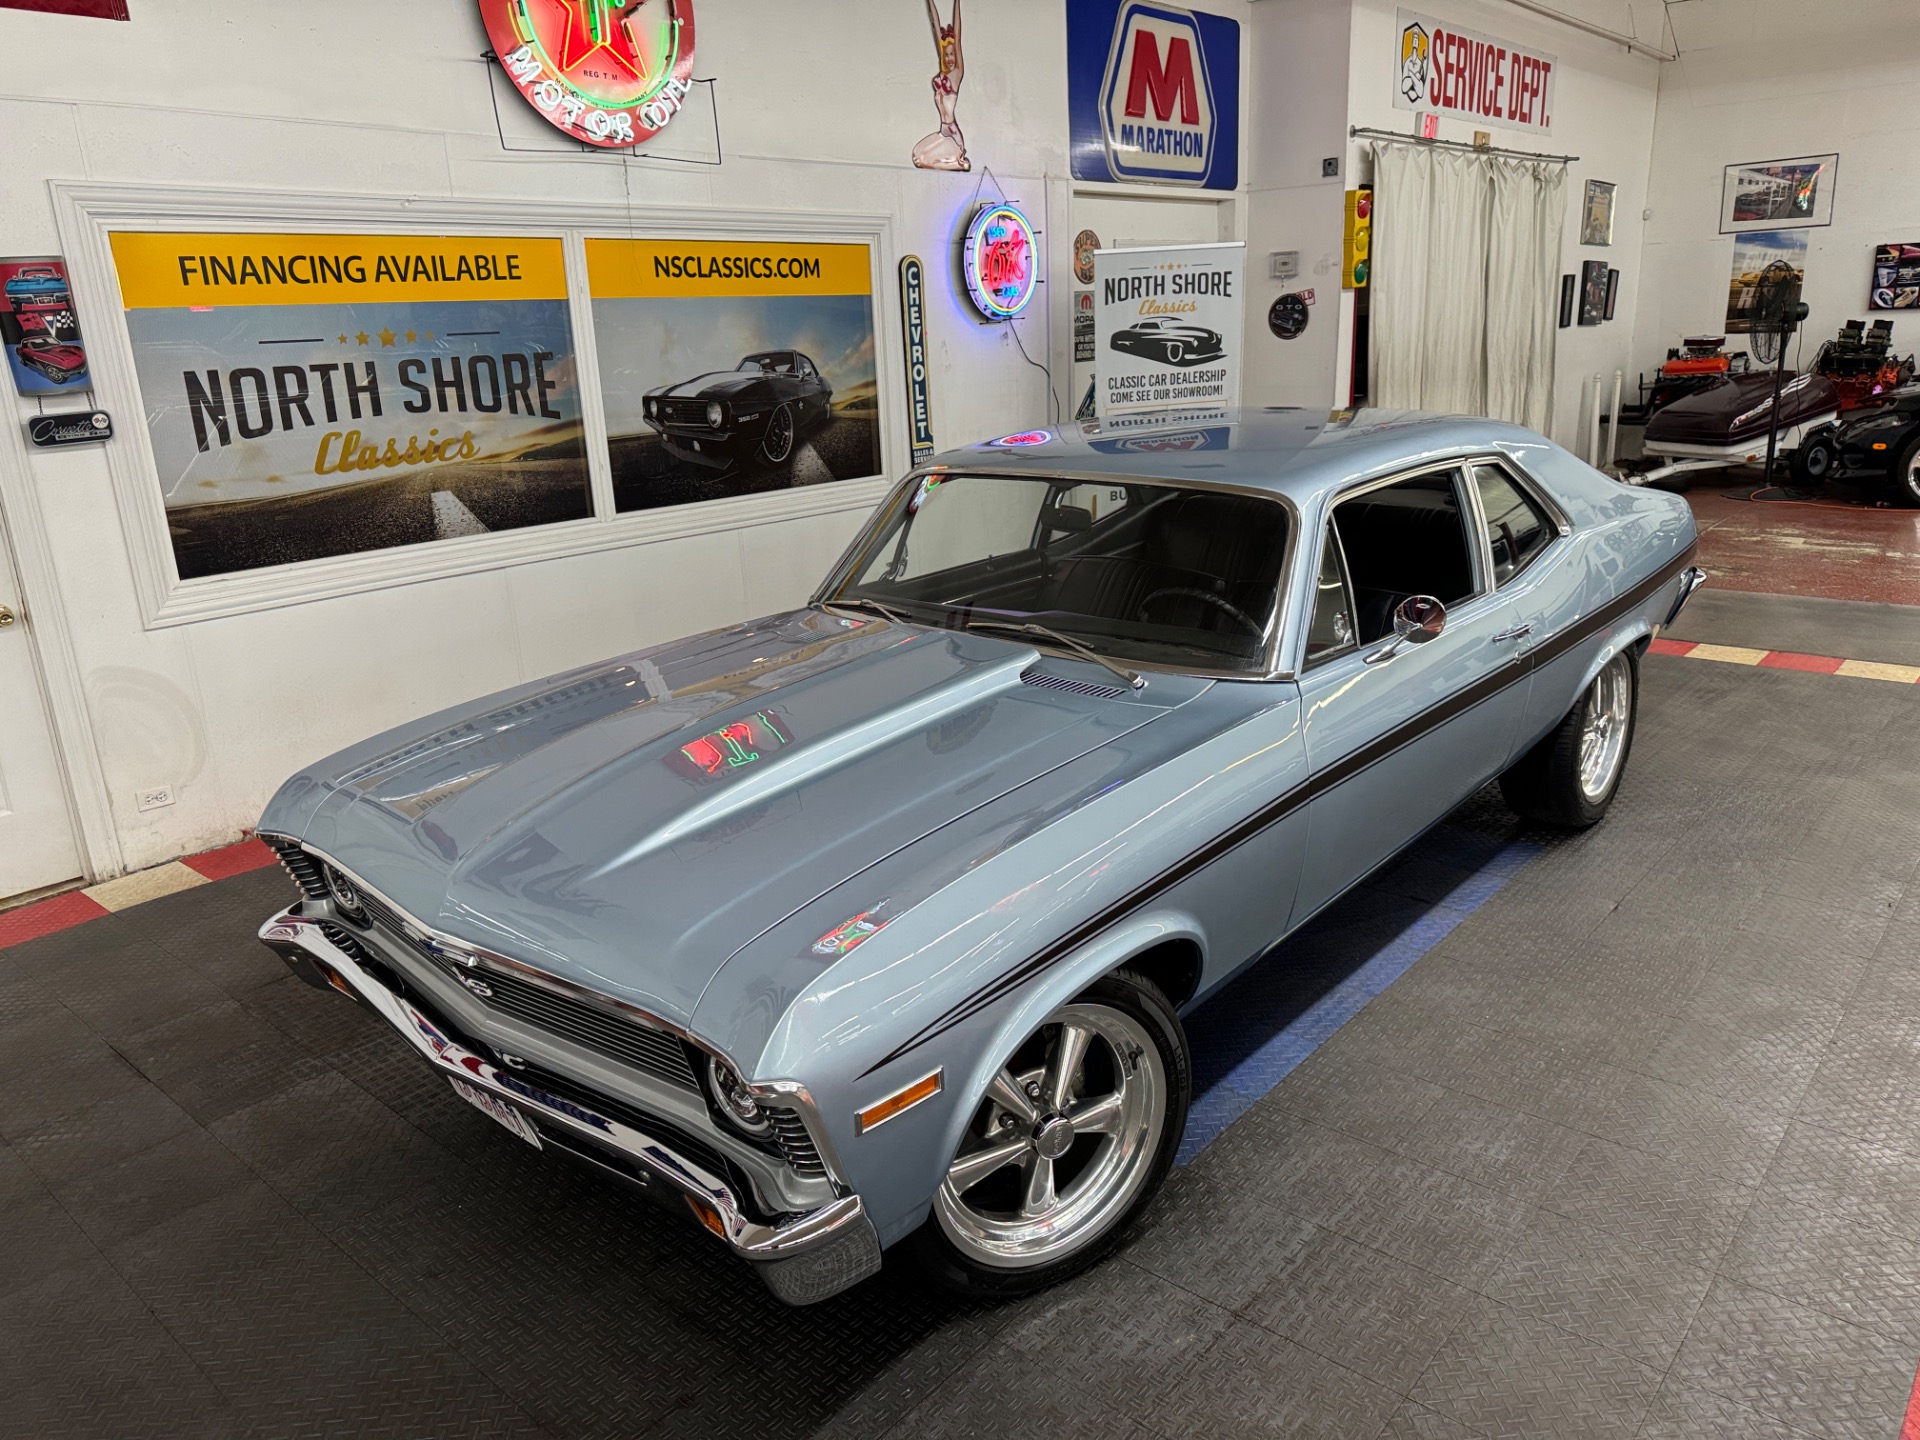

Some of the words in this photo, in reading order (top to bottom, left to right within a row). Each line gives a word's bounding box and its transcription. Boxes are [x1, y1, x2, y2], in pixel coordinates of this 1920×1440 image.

[503, 45, 634, 143] MOTOR
[640, 78, 692, 130] OIL
[1125, 29, 1199, 126] M
[1429, 28, 1506, 118] SERVICE
[1508, 52, 1552, 128] DEPT.
[1121, 124, 1203, 158] MARATHON
[178, 254, 367, 286] FINANCING
[374, 254, 522, 283] AVAILABLE
[653, 255, 821, 279] NSCLASSICS.COM
[1104, 274, 1166, 306] NORTH
[1172, 271, 1232, 297] SHORE
[1074, 315, 1094, 323] MOPA
[1138, 299, 1197, 315] Classics
[907, 266, 928, 438] CHEVROLET
[1108, 375, 1146, 390] CLASSIC
[1148, 373, 1167, 387] CAR
[1170, 369, 1227, 385] DEALERSHIP
[1110, 391, 1134, 403] COME
[1136, 390, 1151, 402] SEE
[1153, 387, 1171, 400] OUR
[1172, 384, 1223, 399] SHOWROOM!
[183, 361, 384, 453] NORTH
[398, 351, 561, 419] SHORE
[314, 428, 480, 476] Classics
